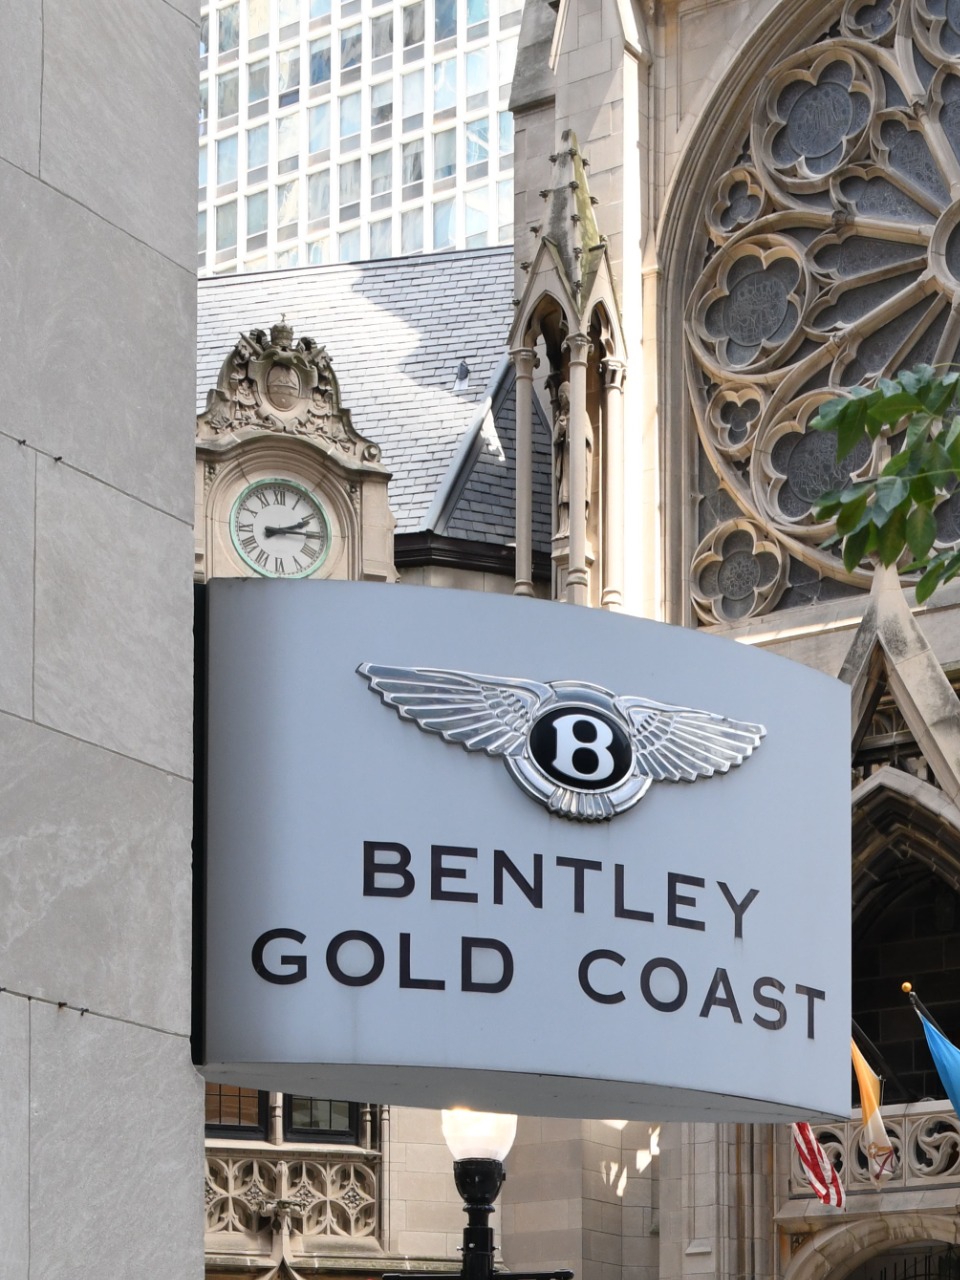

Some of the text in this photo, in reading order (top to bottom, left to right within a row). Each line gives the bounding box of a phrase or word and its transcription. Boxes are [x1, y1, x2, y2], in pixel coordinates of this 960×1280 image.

[255, 492, 270, 509] XI
[273, 490, 286, 506] XII
[552, 714, 615, 781] B
[362, 840, 760, 939] BENTLEY
[250, 927, 826, 1040] GOLD COAST
